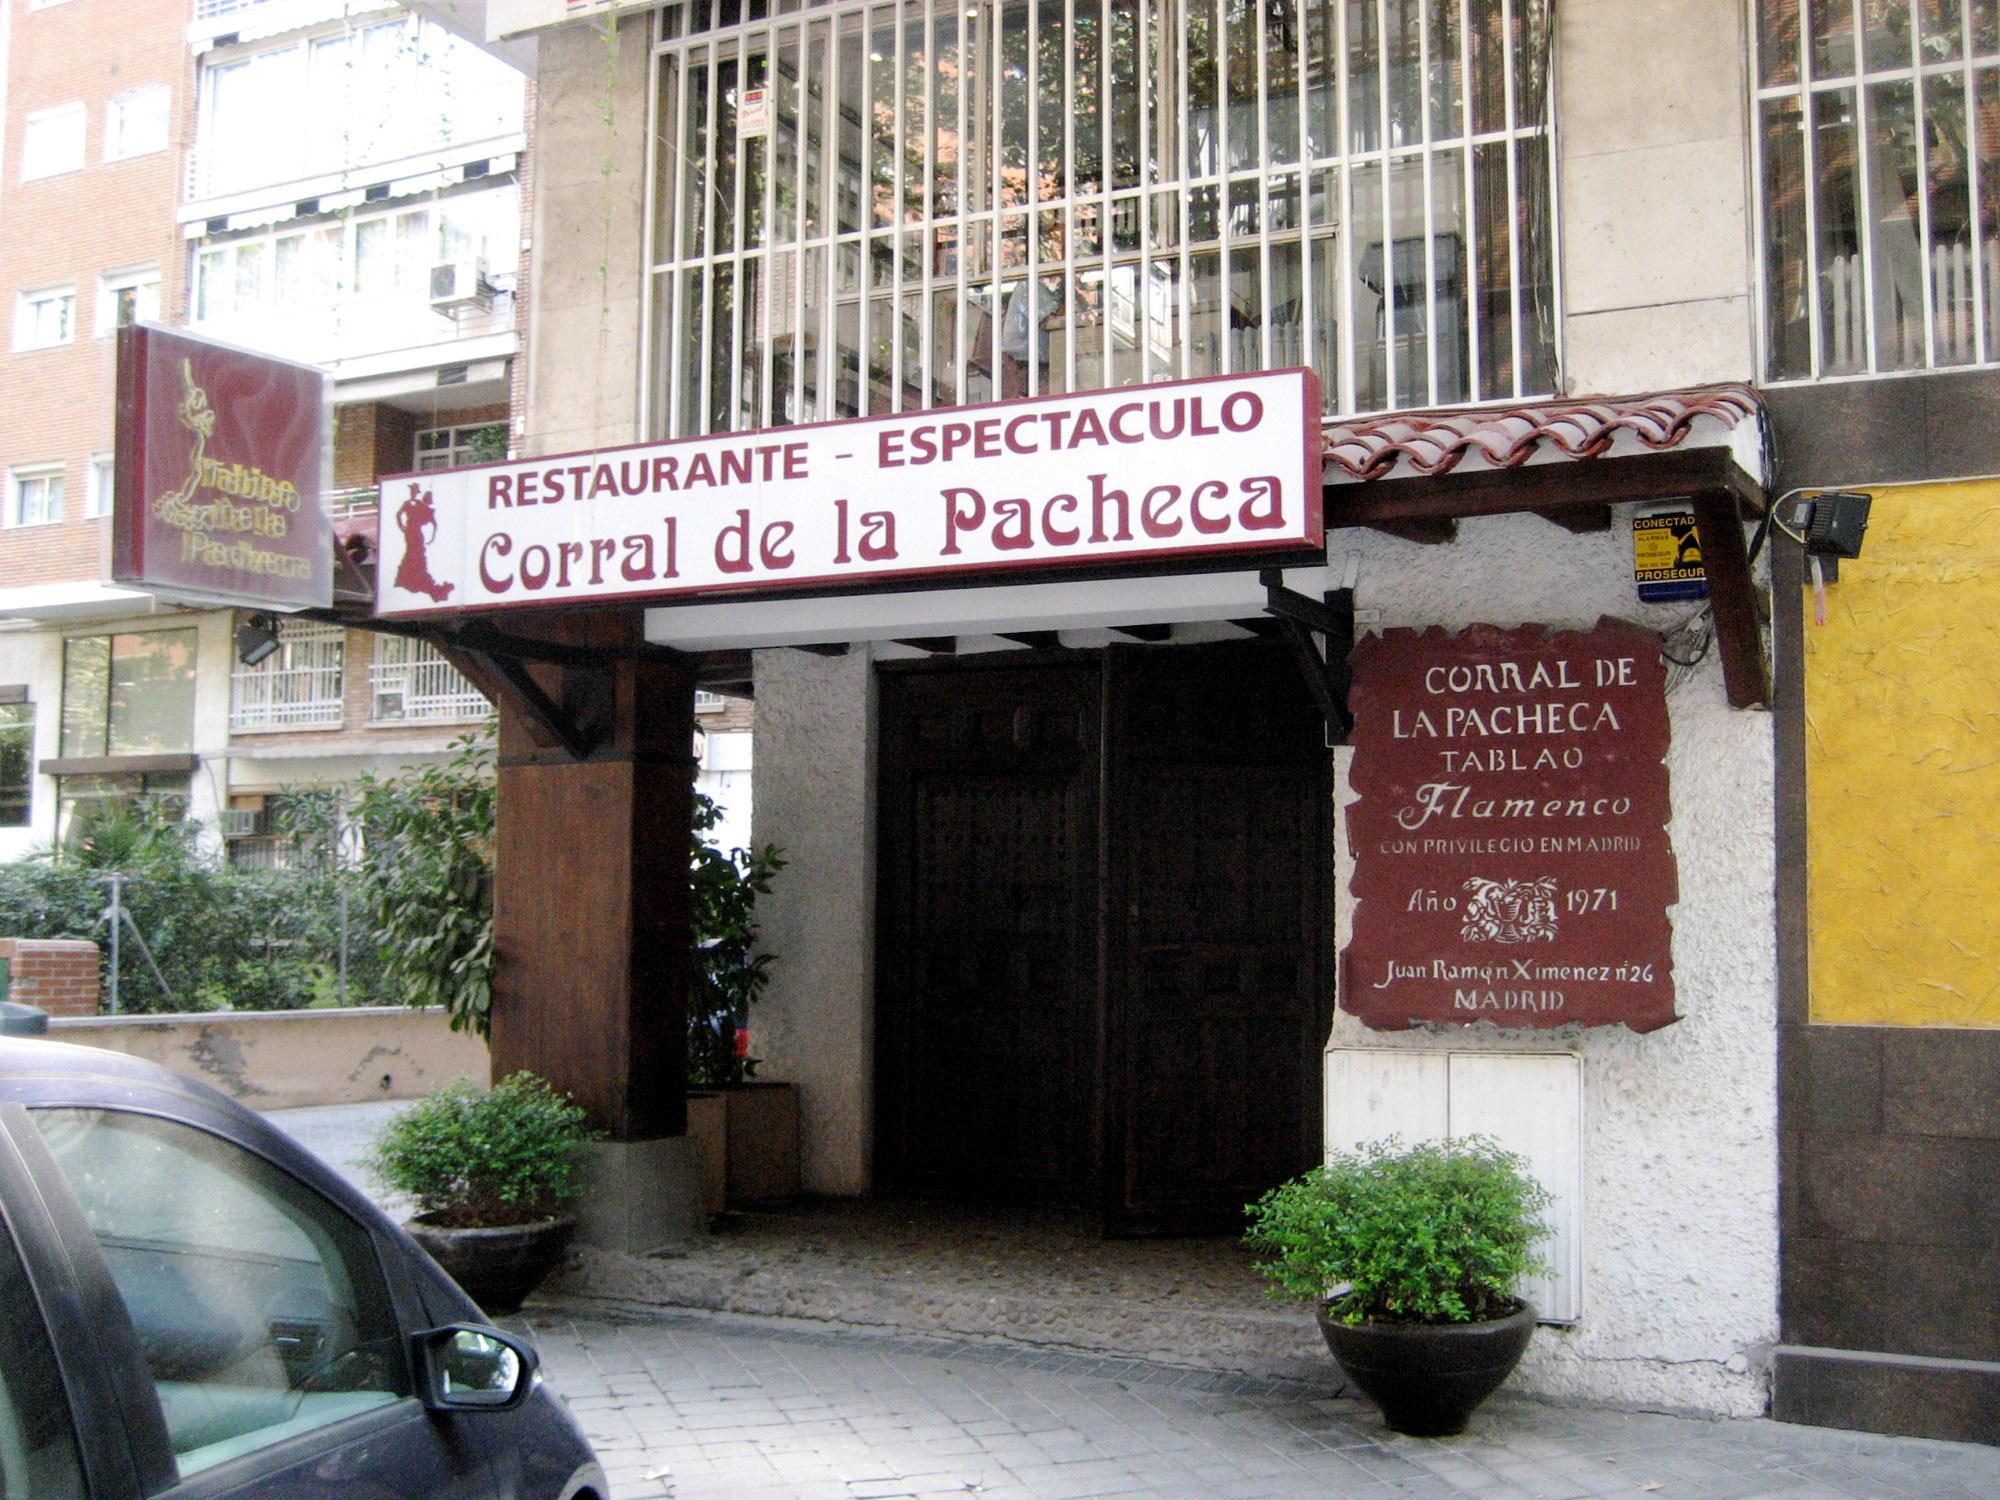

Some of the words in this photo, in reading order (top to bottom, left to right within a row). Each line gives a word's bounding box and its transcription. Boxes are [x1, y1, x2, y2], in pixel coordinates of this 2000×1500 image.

[487, 441, 809, 509] RESTAURANTE
[878, 391, 1264, 468] ESPECTACULO
[479, 516, 681, 594] Corral
[714, 509, 796, 574] de
[833, 499, 899, 564] la
[939, 473, 1287, 556] Pacheca
[1634, 516, 1696, 529] CONECTAD
[1636, 567, 1705, 581] PROSEGUR
[1425, 660, 1581, 694] CORRAL
[1595, 657, 1637, 687] DE
[1393, 709, 1438, 738] LA
[1446, 703, 1620, 738] PACHECA
[1440, 747, 1583, 773] TABLAO
[1393, 781, 1631, 831] Flamenco
[1380, 840, 1418, 854] CON
[1541, 837, 1563, 853] EN
[1567, 836, 1641, 852] MADRID
[1407, 888, 1457, 912] Año
[1566, 888, 1617, 915] 1971
[1373, 960, 1427, 989] Juan
[1511, 959, 1610, 981] Ximenez
[1454, 988, 1565, 1012] MADRID
